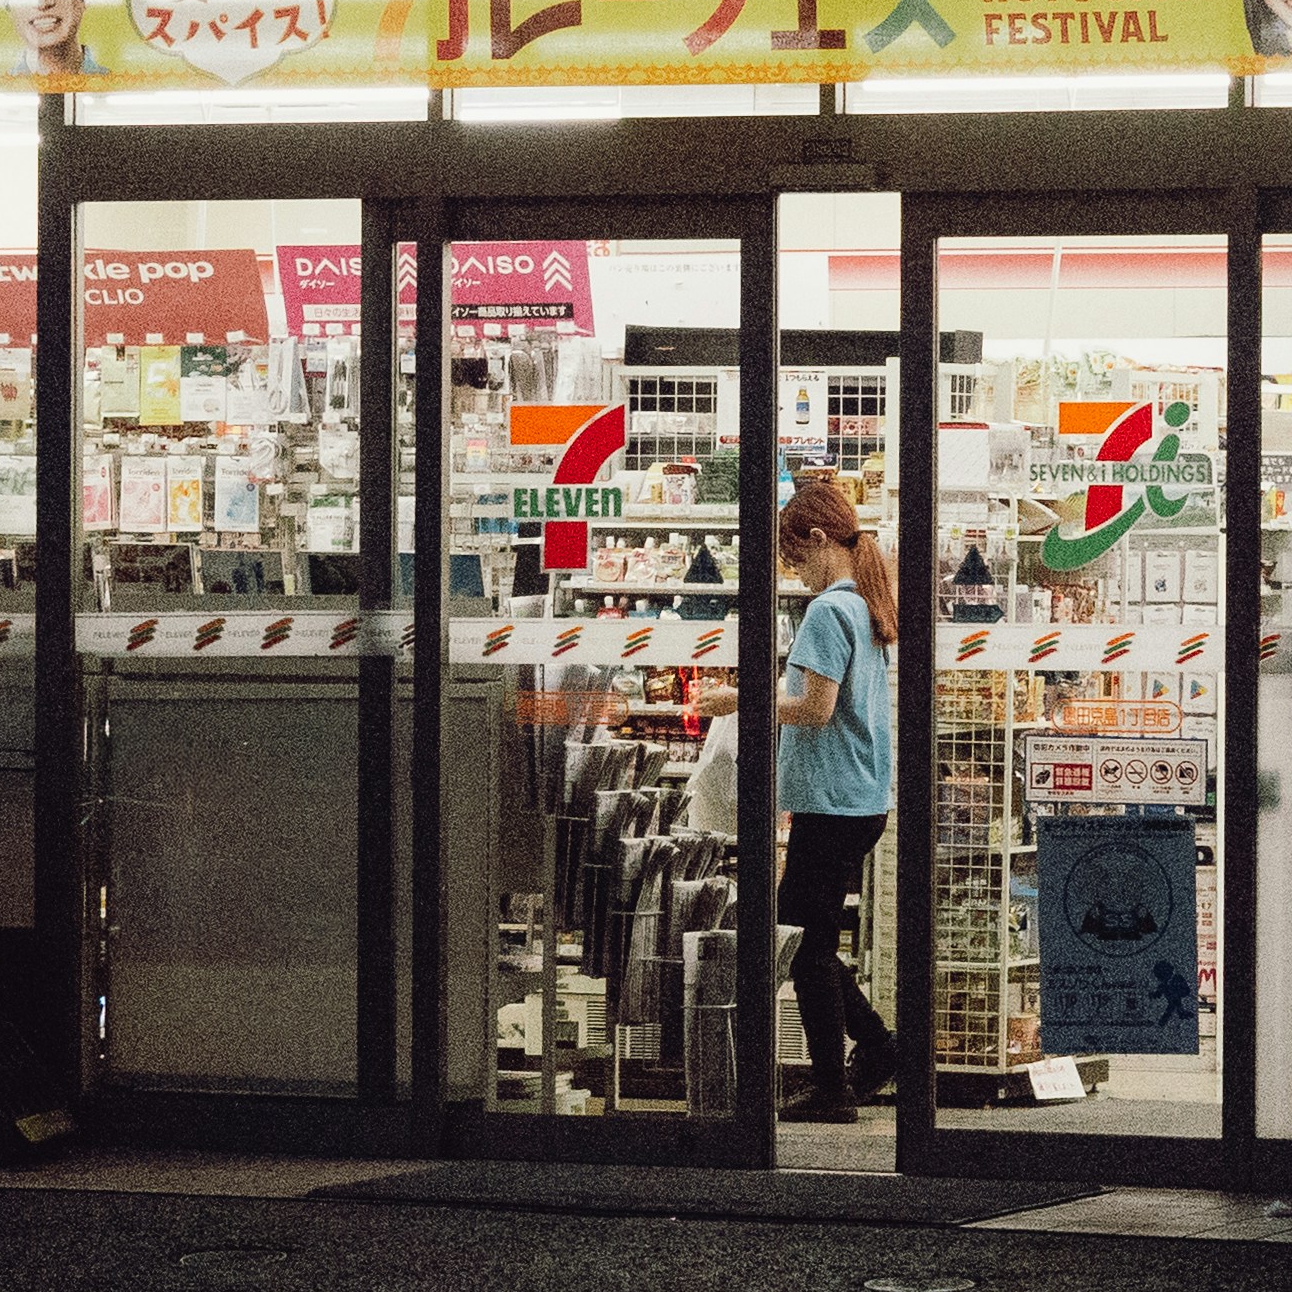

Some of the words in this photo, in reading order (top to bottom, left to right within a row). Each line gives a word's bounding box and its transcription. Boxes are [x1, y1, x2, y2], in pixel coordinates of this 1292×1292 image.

[984, 10, 1169, 46] FESTIVAL
[138, 260, 215, 283] pop
[84, 288, 145, 305] CLIO
